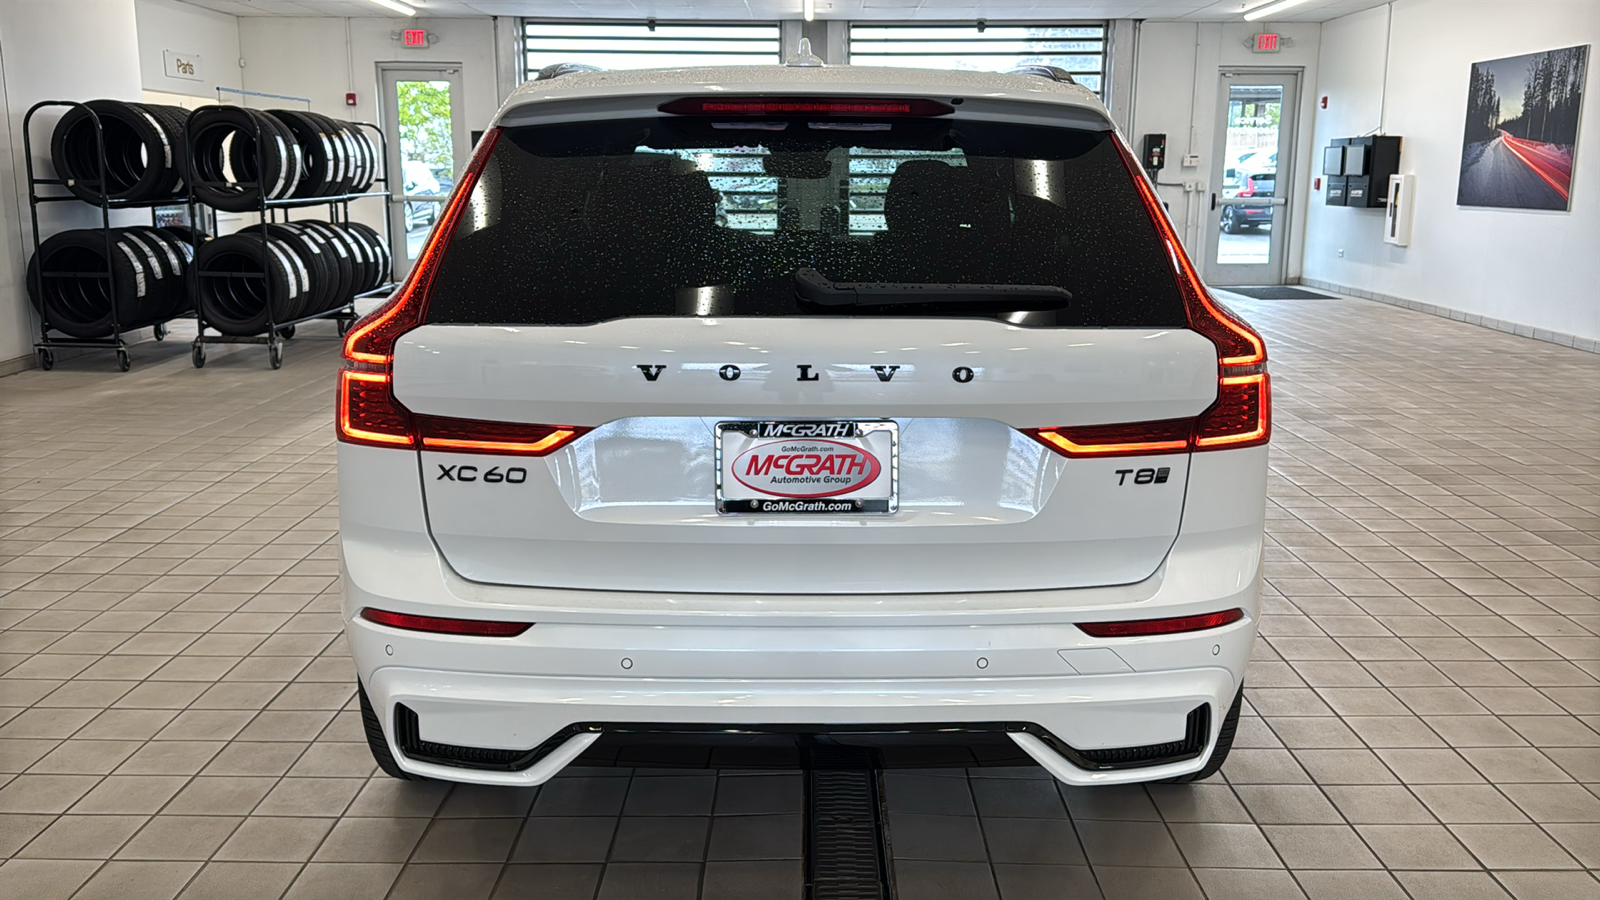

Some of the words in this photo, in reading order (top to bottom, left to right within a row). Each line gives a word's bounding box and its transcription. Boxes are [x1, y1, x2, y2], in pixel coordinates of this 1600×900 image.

[404, 29, 424, 46] EXIT
[1258, 33, 1278, 50] EXIT
[176, 58, 195, 75] Parts
[636, 364, 975, 383] VOLVO
[781, 445, 834, 453] GoMcGrath.com
[770, 475, 821, 484] Automotive
[823, 475, 852, 486] Group
[1115, 468, 1156, 487] T8
[762, 501, 852, 512] GoMcGrath.com
